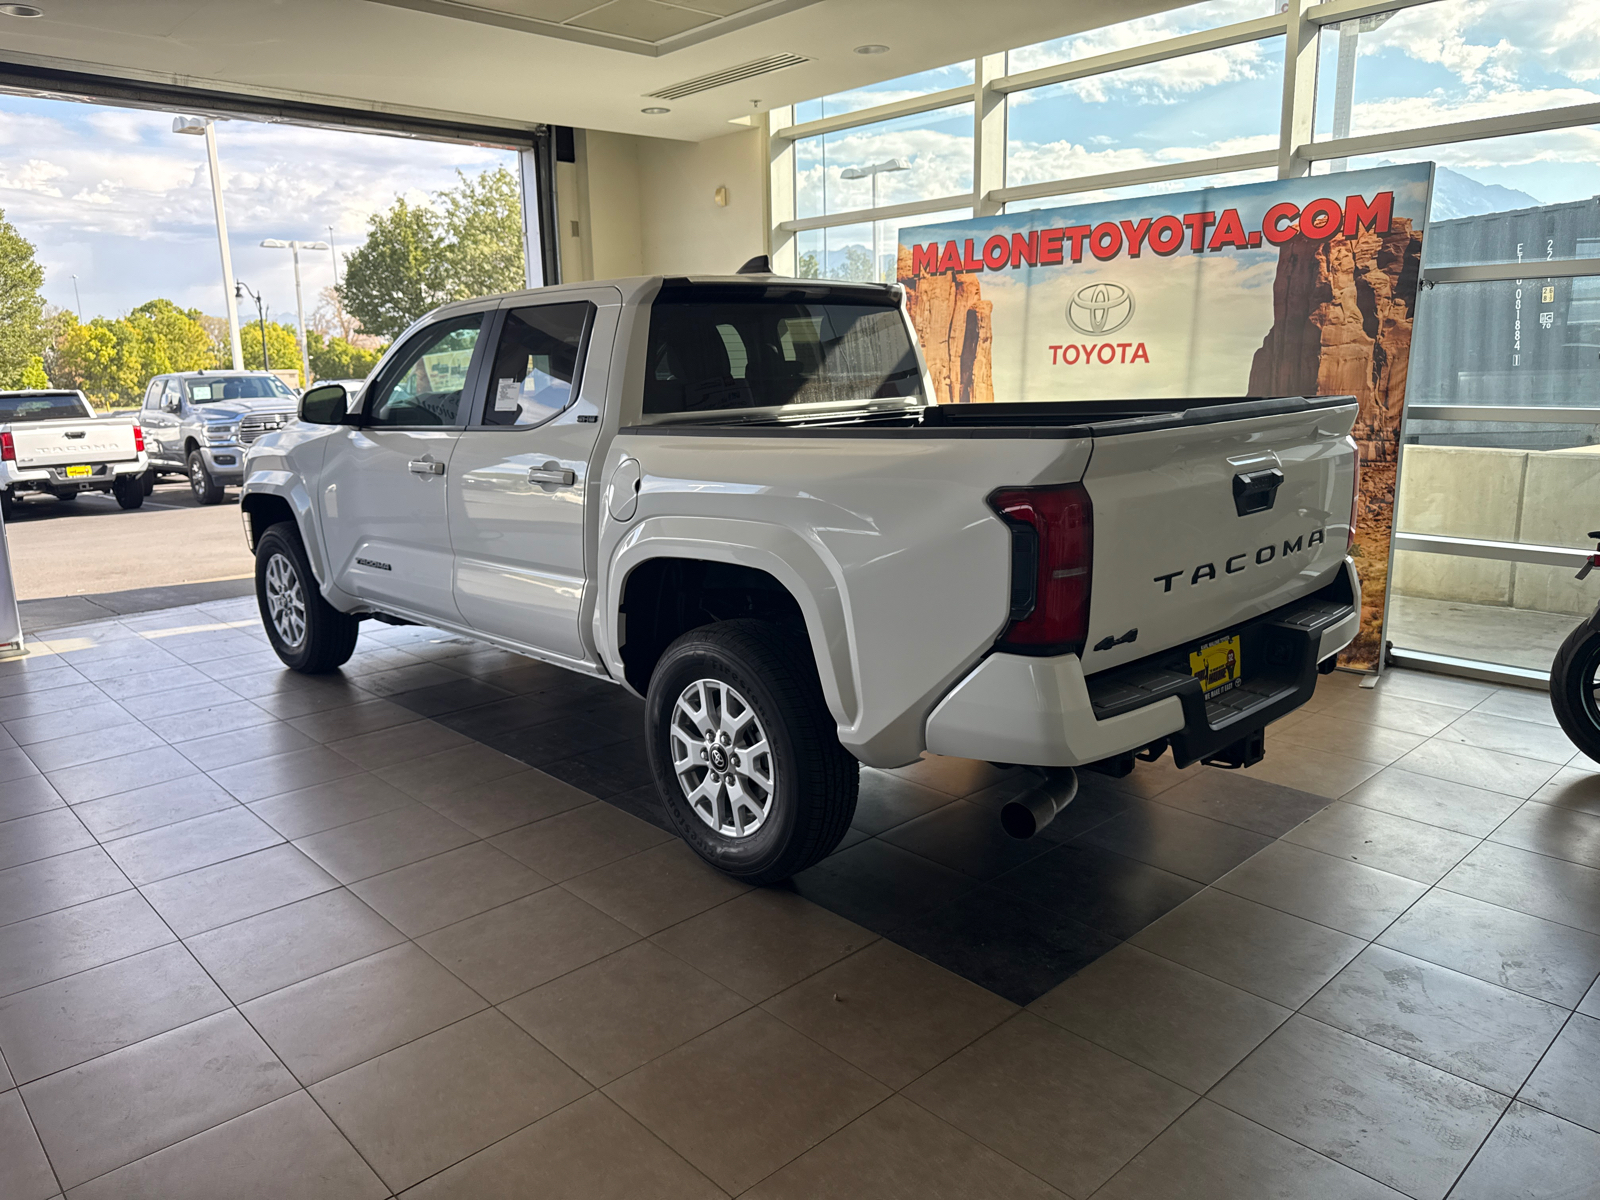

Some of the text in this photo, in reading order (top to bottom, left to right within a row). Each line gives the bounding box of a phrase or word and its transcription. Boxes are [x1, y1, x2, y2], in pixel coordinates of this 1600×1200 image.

[912, 191, 1395, 276] MALONETOYOTA.COM
[1048, 342, 1150, 366] TOYOTA
[35, 443, 119, 455] TACOMA
[1153, 528, 1325, 593] TACOMA
[711, 659, 771, 727] Firestone
[662, 787, 716, 858] Firestone
